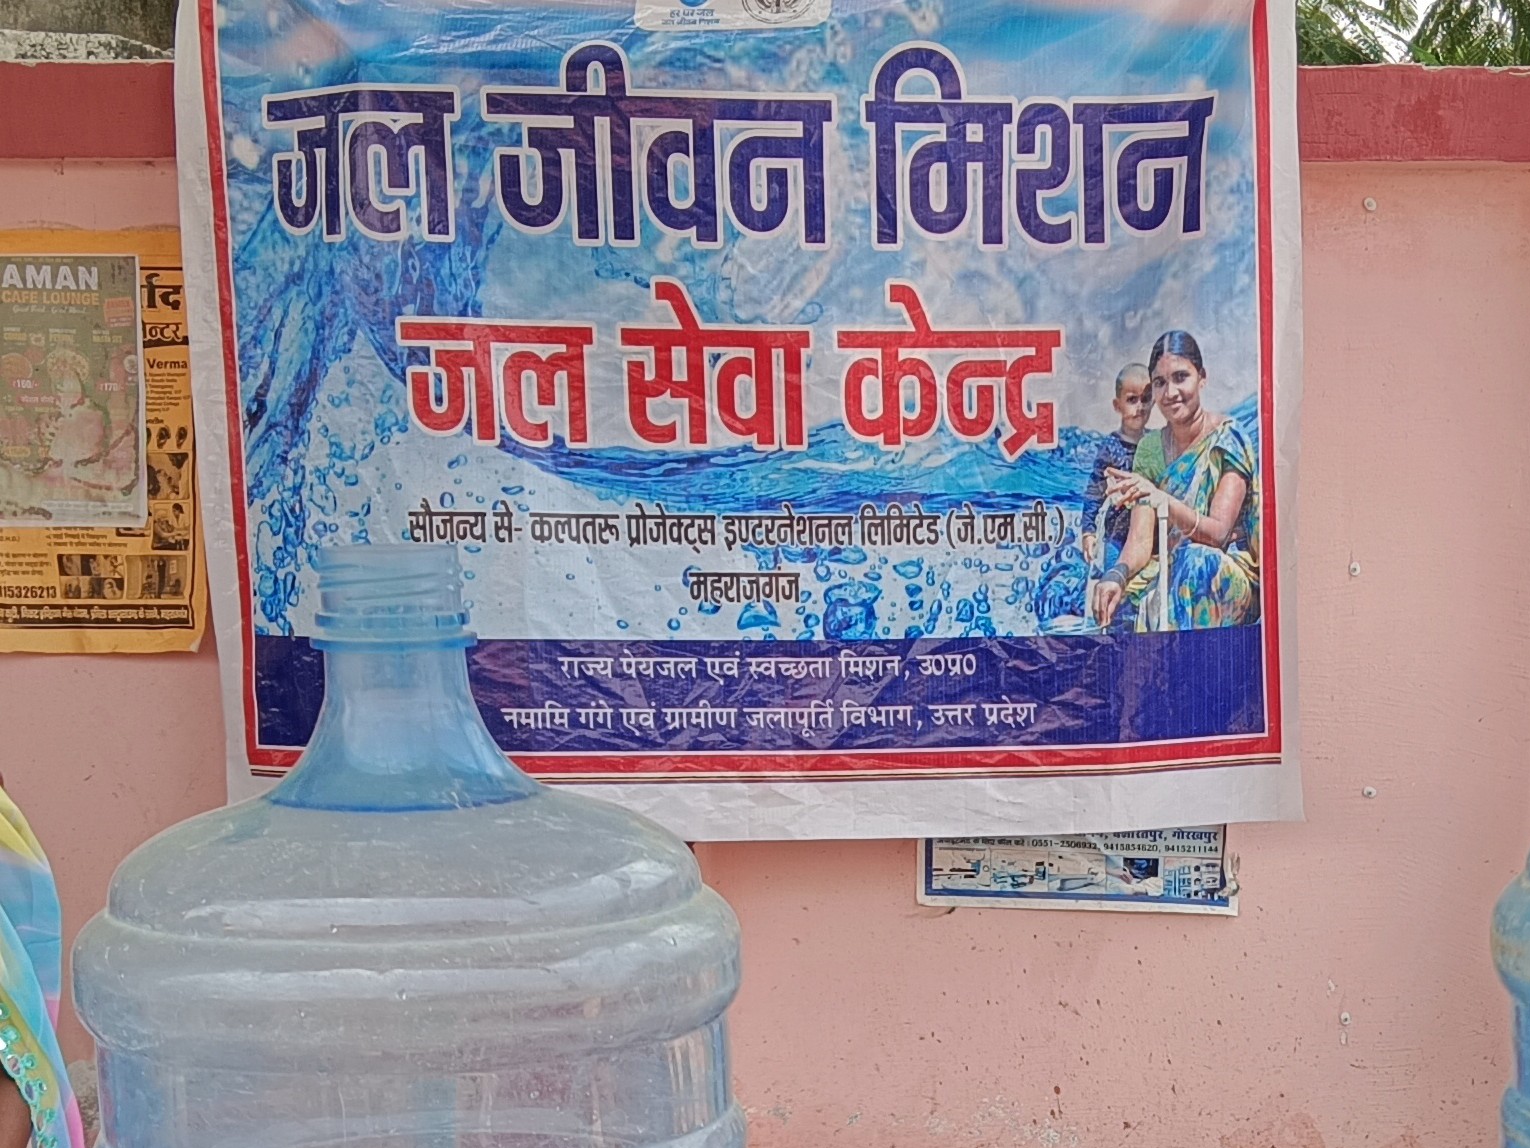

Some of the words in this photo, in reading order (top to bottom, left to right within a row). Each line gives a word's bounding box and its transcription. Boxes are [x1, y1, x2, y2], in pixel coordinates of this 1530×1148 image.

[263, 86, 458, 241] जल
[483, 43, 834, 245] जीवन
[863, 45, 1216, 247] मिशन
[1, 263, 99, 290] AMAN
[1, 290, 39, 305] CAFE
[42, 291, 100, 306] LOUNGE
[146, 357, 188, 369] Verma
[398, 320, 595, 445] जल
[619, 279, 812, 448] सेवा
[836, 282, 1064, 458] केन्द्र
[408, 498, 487, 543] सौजन्य
[626, 502, 716, 553] प्रोजेक्ट्स
[722, 502, 854, 551] इण्टरनेशनल
[860, 502, 940, 546] लिमिटेड
[946, 500, 1066, 549] (जे.एम.सी.)
[689, 565, 801, 604] महराजगंज
[558, 655, 614, 680] राज्य
[620, 649, 698, 680] पेयजल
[706, 651, 740, 685] एवं
[747, 656, 833, 680] स्वच्छता
[838, 650, 910, 681] मिशन,
[501, 700, 569, 730] नमामि
[576, 700, 615, 729] गंगे
[621, 700, 657, 735] एवं
[664, 699, 738, 730] ग्रामीण
[744, 698, 833, 736] जलापूर्ति
[841, 699, 924, 731] विभाग,
[927, 703, 976, 729] उत्तर
[980, 696, 1038, 729] प्रदेश
[1171, 827, 1219, 844] गोरखपुर
